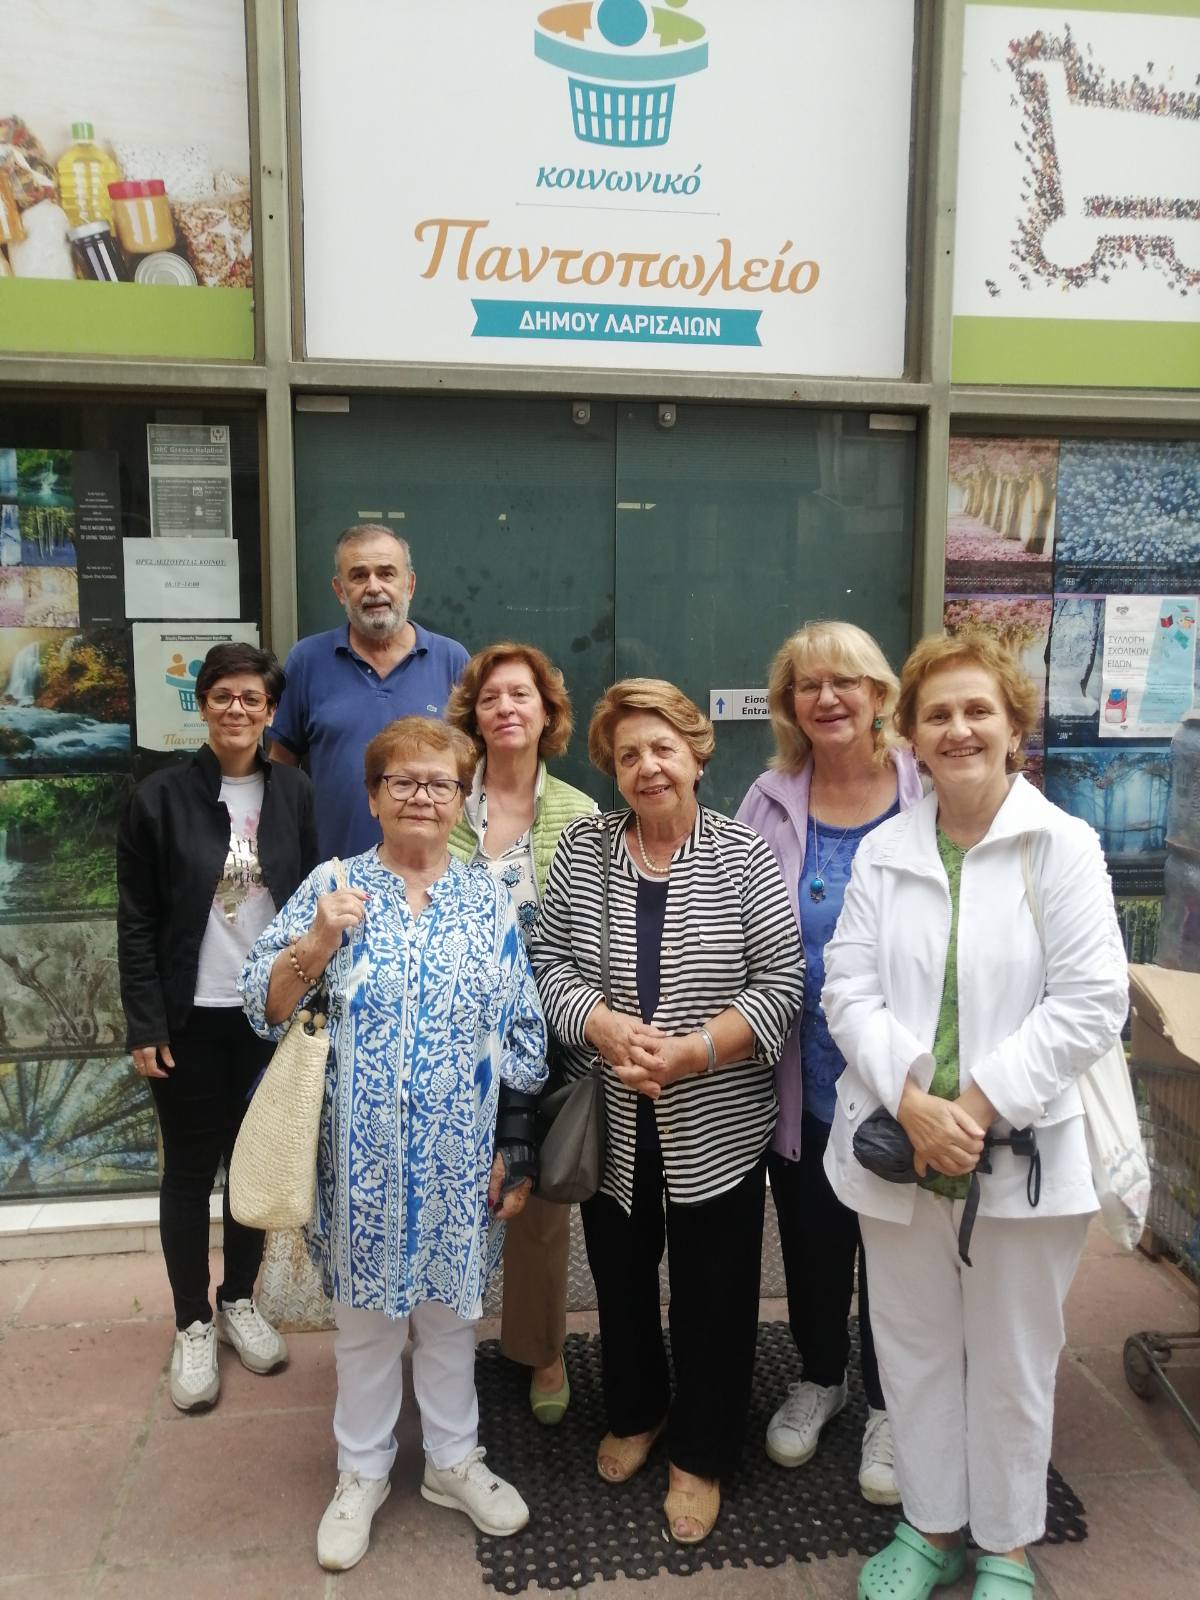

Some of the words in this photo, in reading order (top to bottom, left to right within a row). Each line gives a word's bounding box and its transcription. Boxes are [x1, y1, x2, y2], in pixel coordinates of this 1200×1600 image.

[536, 164, 703, 195] κοινωνικό
[414, 218, 820, 297] Παντοπωλείο
[519, 310, 600, 334] ΔΗΜΟΥ
[604, 313, 721, 338] ΛΑΡΙΣΑΙΩΝ
